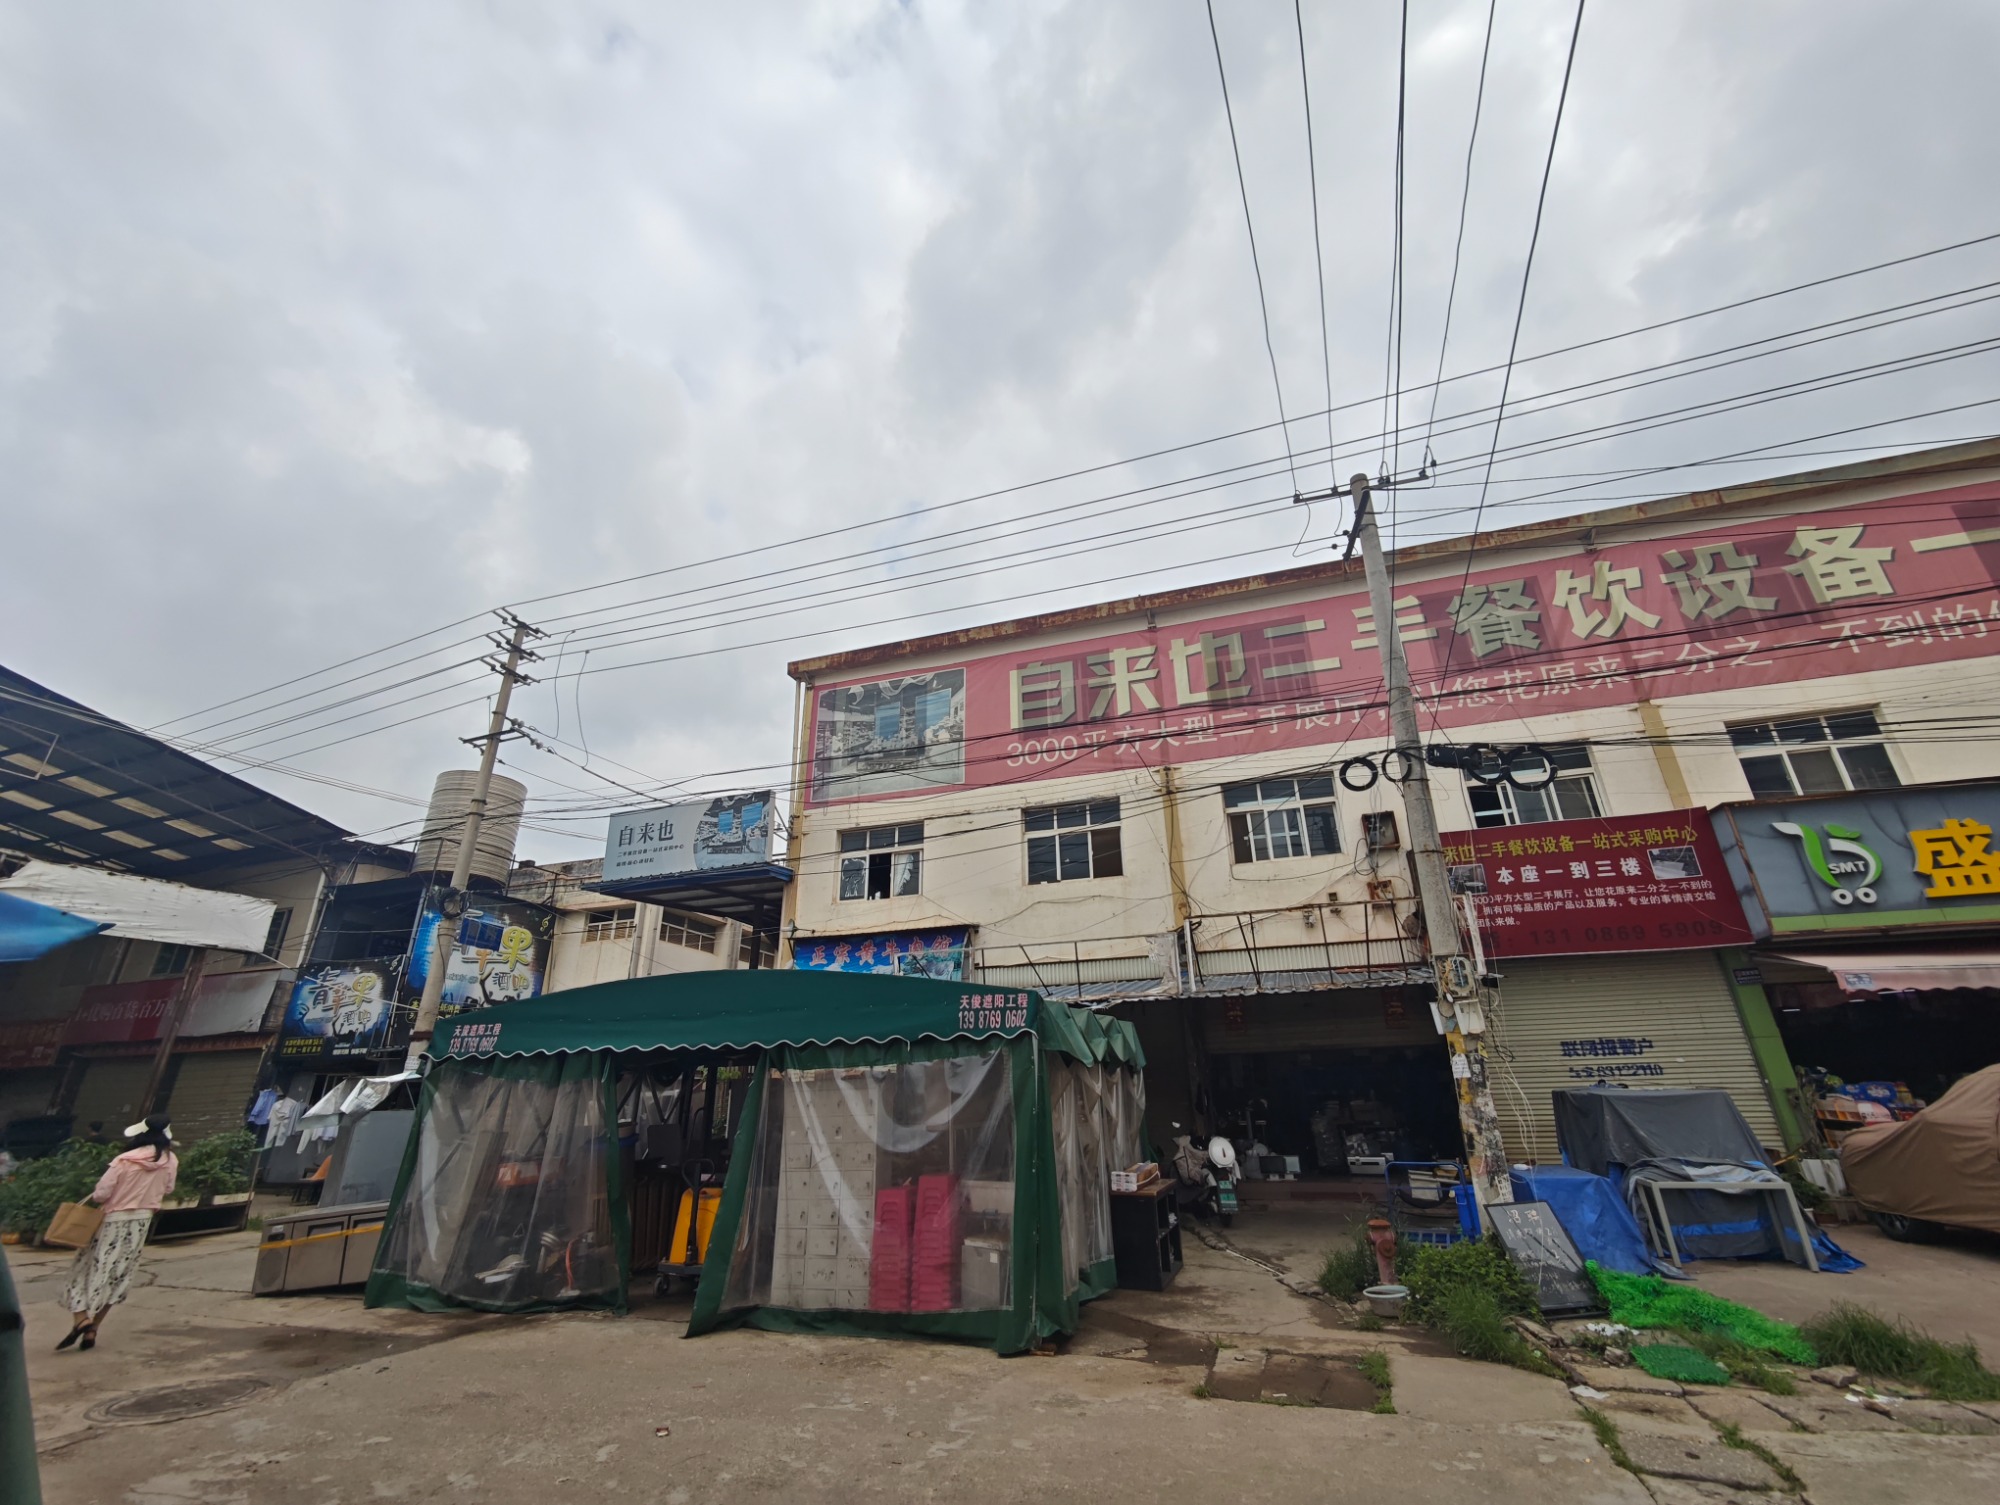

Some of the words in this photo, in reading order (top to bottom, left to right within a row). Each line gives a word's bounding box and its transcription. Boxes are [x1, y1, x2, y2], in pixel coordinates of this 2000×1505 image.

[1006, 599, 2000, 769] 3000平方大型二手展厅，让您花原来二分之一不到的
[618, 819, 674, 847] 自来也
[1827, 860, 1866, 875] SMT
[1907, 817, 2000, 898] 盛
[1495, 856, 1642, 886] 本座一到三楼
[809, 935, 953, 967] 正宗黄牛肉馆
[493, 971, 530, 991] 酒吧
[959, 993, 1029, 1009] 天俊遮阳工程
[343, 1008, 372, 1026] 酒吧
[958, 1010, 975, 1029] 139
[978, 1010, 1002, 1029] 8769
[1005, 1009, 1027, 1028] 0602
